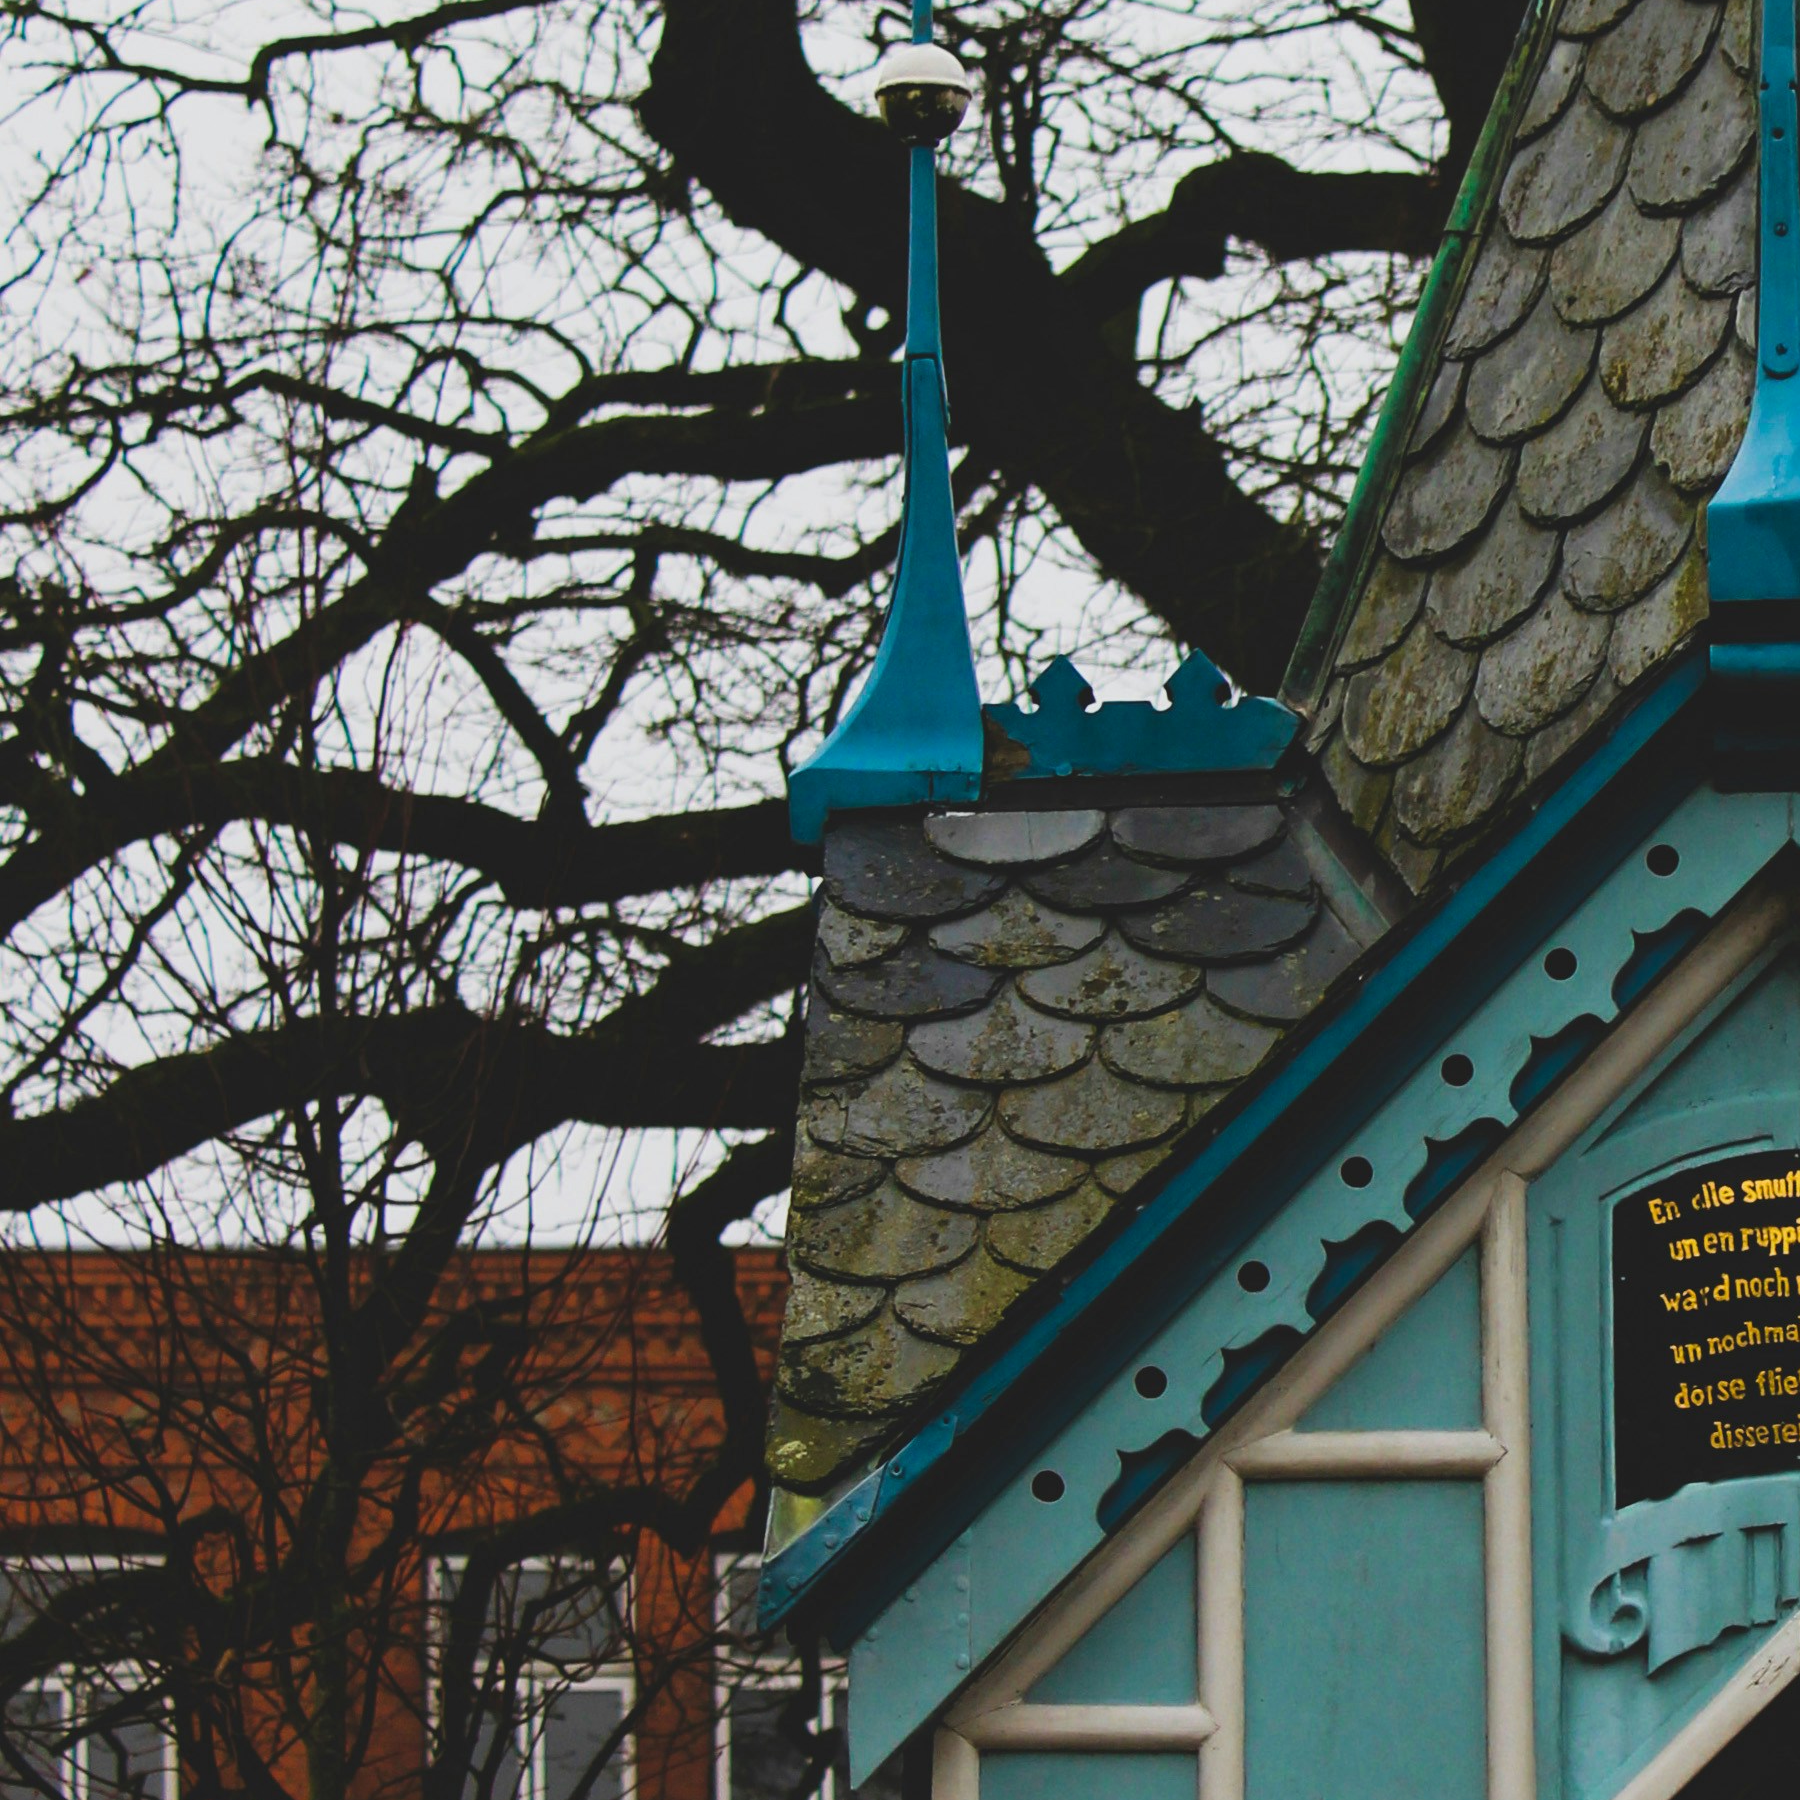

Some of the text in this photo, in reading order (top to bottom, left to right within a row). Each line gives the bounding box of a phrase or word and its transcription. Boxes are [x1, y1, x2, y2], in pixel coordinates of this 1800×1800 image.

[1648, 1198, 1681, 1224] En
[1670, 1343, 1702, 1364] un
[1710, 1421, 1769, 1449] disse
